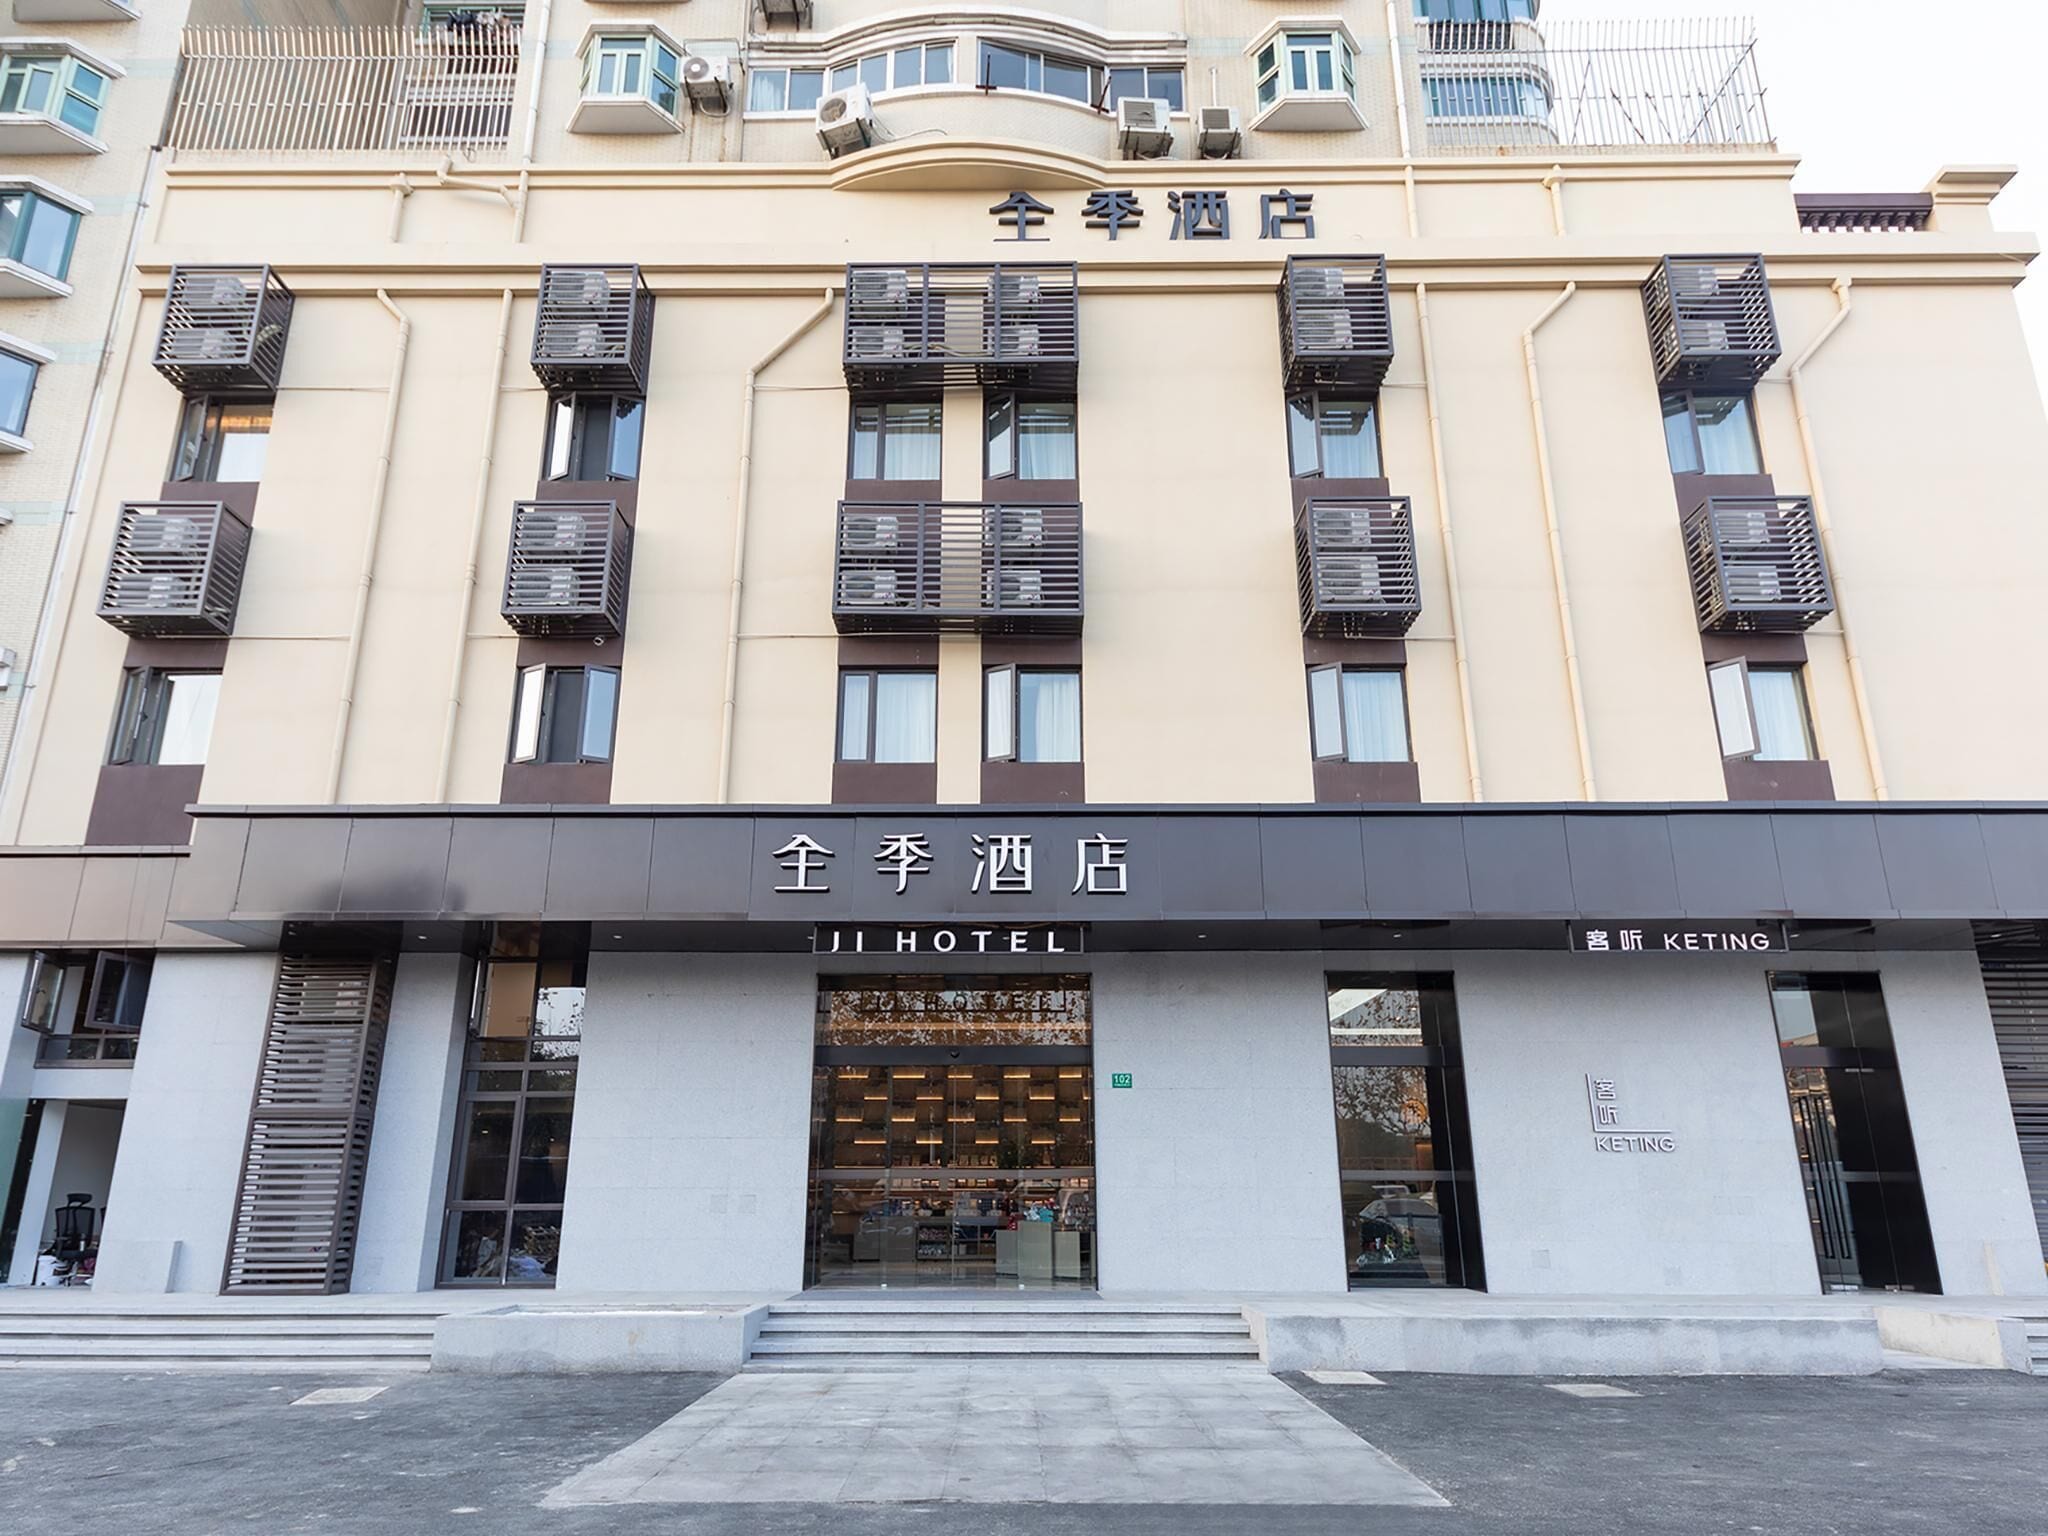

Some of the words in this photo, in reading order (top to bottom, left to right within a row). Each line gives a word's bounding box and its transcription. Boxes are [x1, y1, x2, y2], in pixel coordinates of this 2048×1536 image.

[989, 188, 1316, 241] 全季酒店
[772, 832, 1129, 894] 全季酒店
[831, 930, 864, 952] JI
[896, 930, 1065, 952] HOTEL
[1586, 929, 1643, 951] 客听
[1663, 932, 1770, 951] KETING
[1114, 1074, 1131, 1083] 102
[1594, 1136, 1676, 1153] KETING
